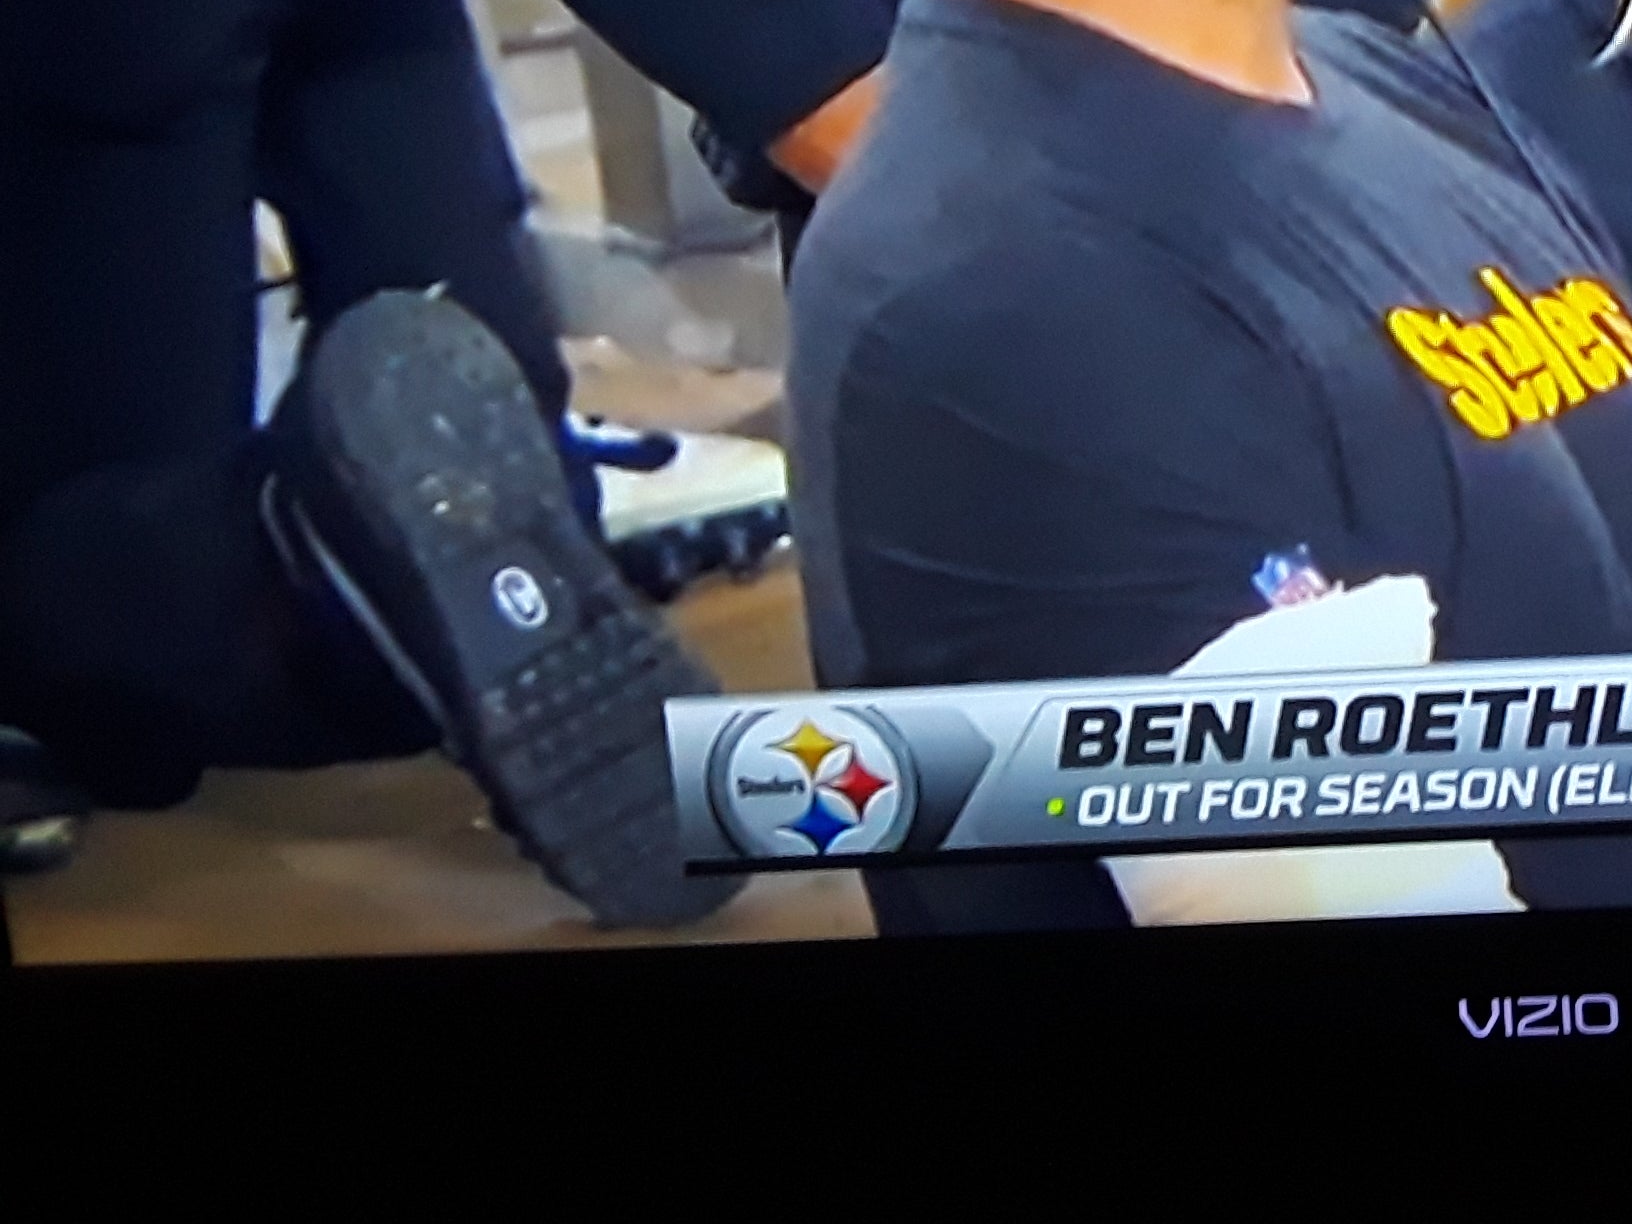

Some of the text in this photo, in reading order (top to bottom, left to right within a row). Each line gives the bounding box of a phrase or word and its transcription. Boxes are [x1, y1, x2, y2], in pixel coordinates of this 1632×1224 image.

[1058, 698, 1251, 768] BEN
[1077, 778, 1193, 826] OUT
[1199, 774, 1311, 821] FOR
[1315, 766, 1537, 817] SEASON
[1458, 992, 1619, 1039] VIZIO
